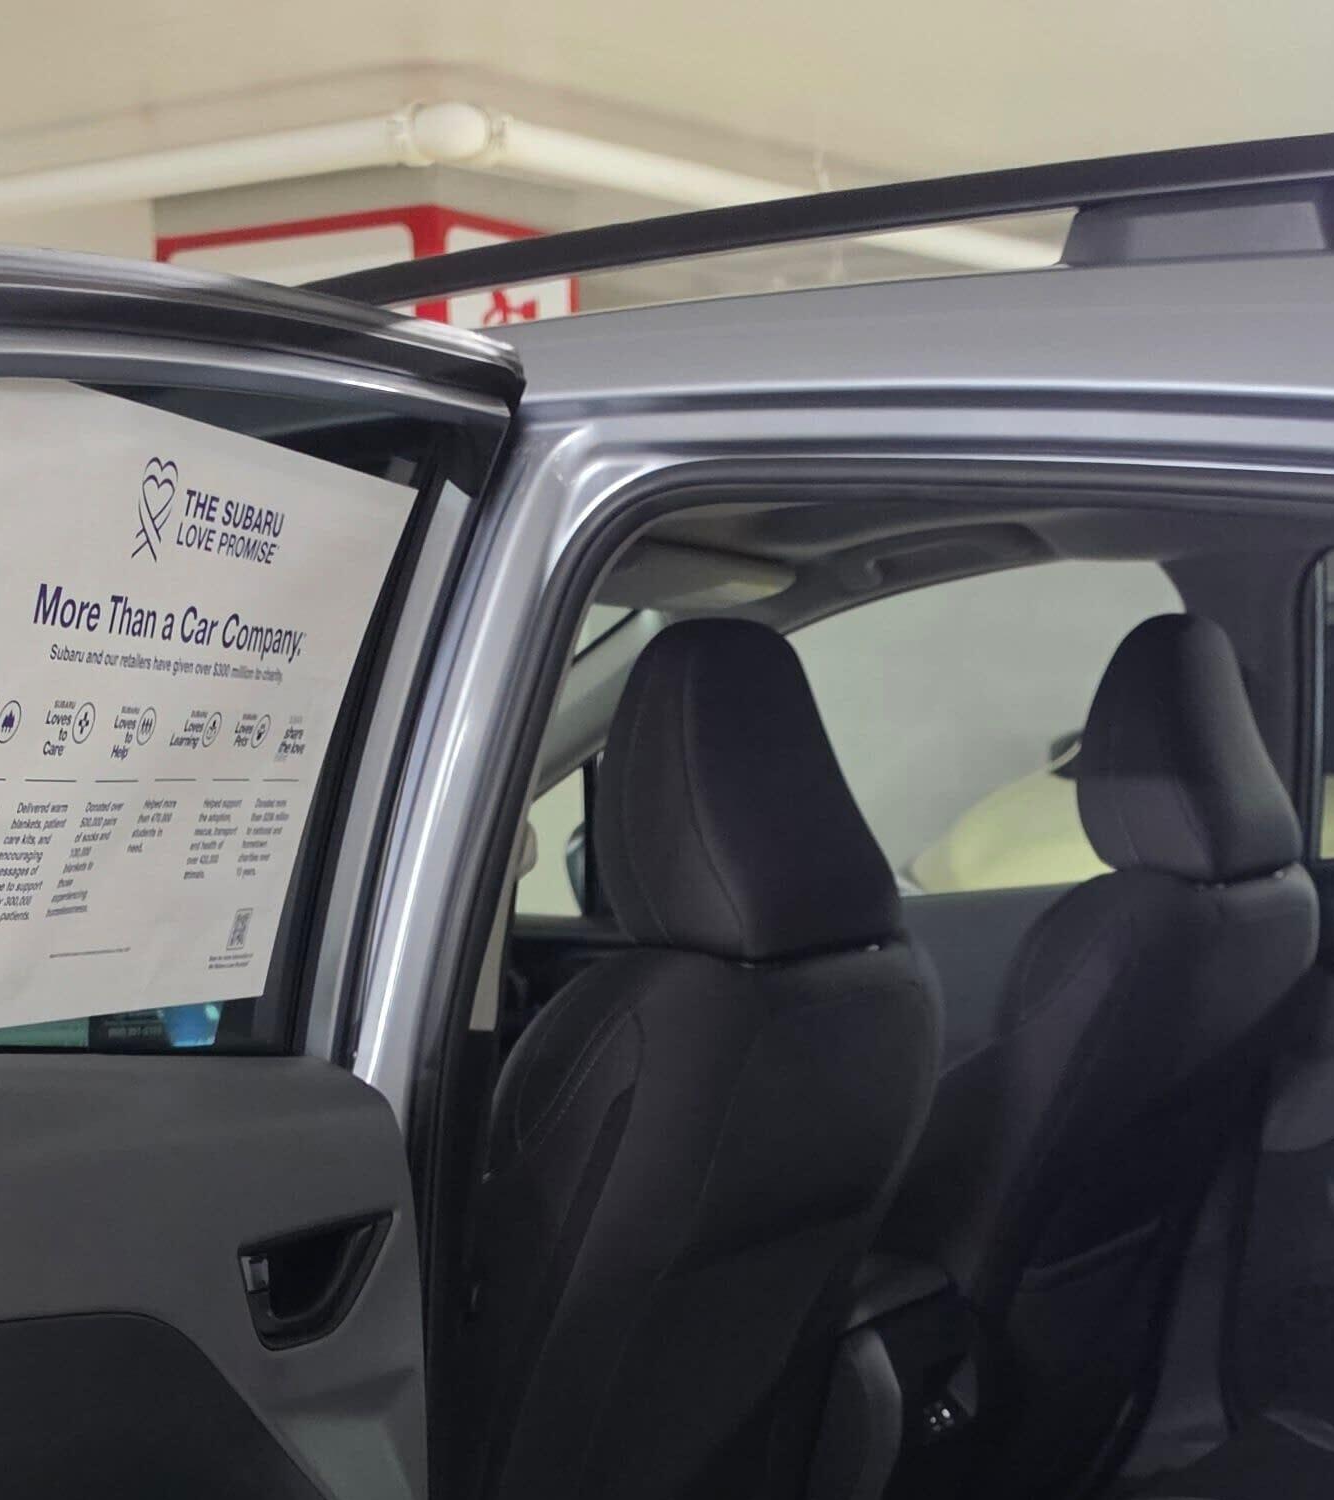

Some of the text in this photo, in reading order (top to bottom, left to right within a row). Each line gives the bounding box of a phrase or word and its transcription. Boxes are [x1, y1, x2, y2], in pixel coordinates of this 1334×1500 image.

[185, 490, 285, 537] THE SUBARU
[176, 522, 276, 564] LOVE PROMISE
[33, 583, 302, 664] More Than a Car Company.
[50, 643, 85, 662] Subaru
[86, 649, 104, 665] and
[104, 653, 119, 666] our
[120, 652, 152, 670] retailers
[153, 655, 171, 671] have
[172, 657, 193, 676] given
[195, 662, 212, 675] over
[45, 710, 72, 726] Loves
[114, 715, 137, 730] Loves
[184, 719, 204, 733] Loves
[58, 728, 68, 741] to
[124, 732, 133, 744] to
[170, 734, 200, 749] Learning
[42, 741, 64, 756] Care
[110, 745, 129, 760] Help
